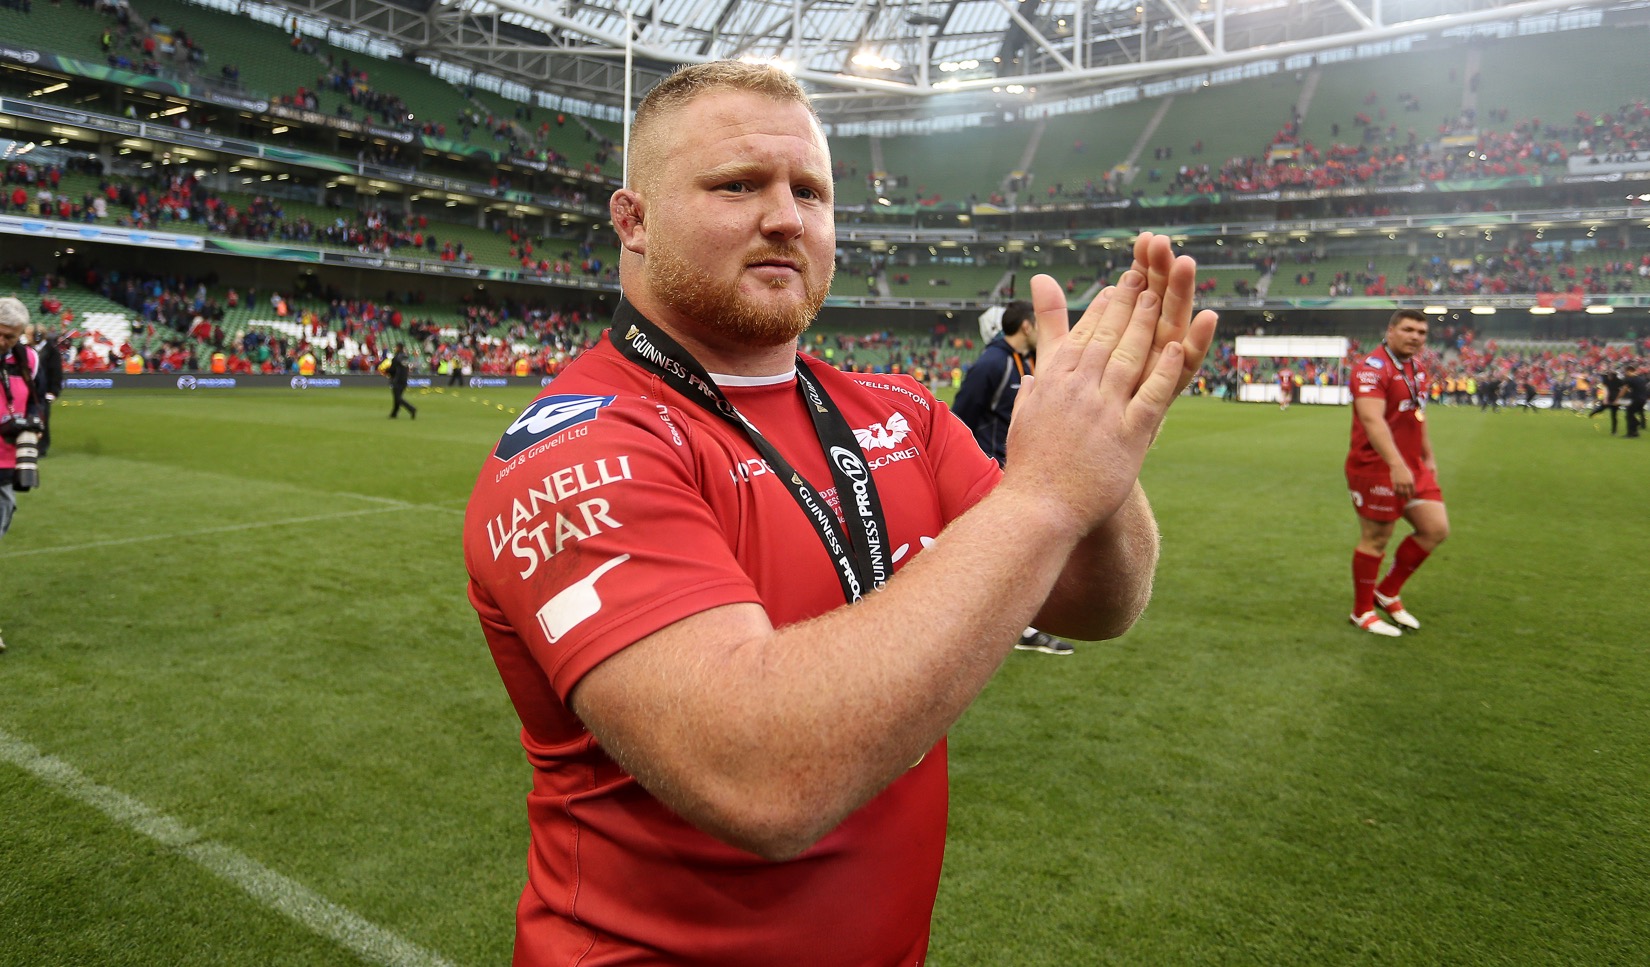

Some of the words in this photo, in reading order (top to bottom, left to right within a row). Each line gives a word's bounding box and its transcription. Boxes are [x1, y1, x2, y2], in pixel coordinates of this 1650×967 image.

[632, 333, 687, 379] GUINNESS
[495, 461, 516, 483] Lloyd
[518, 455, 526, 465] &
[528, 434, 564, 459] Gravell
[568, 426, 588, 440] Ltd
[486, 455, 632, 561] LLANELLI
[511, 498, 623, 580] STAR
[799, 486, 843, 555] GUINNESS
[863, 519, 886, 592] GUINNESS
